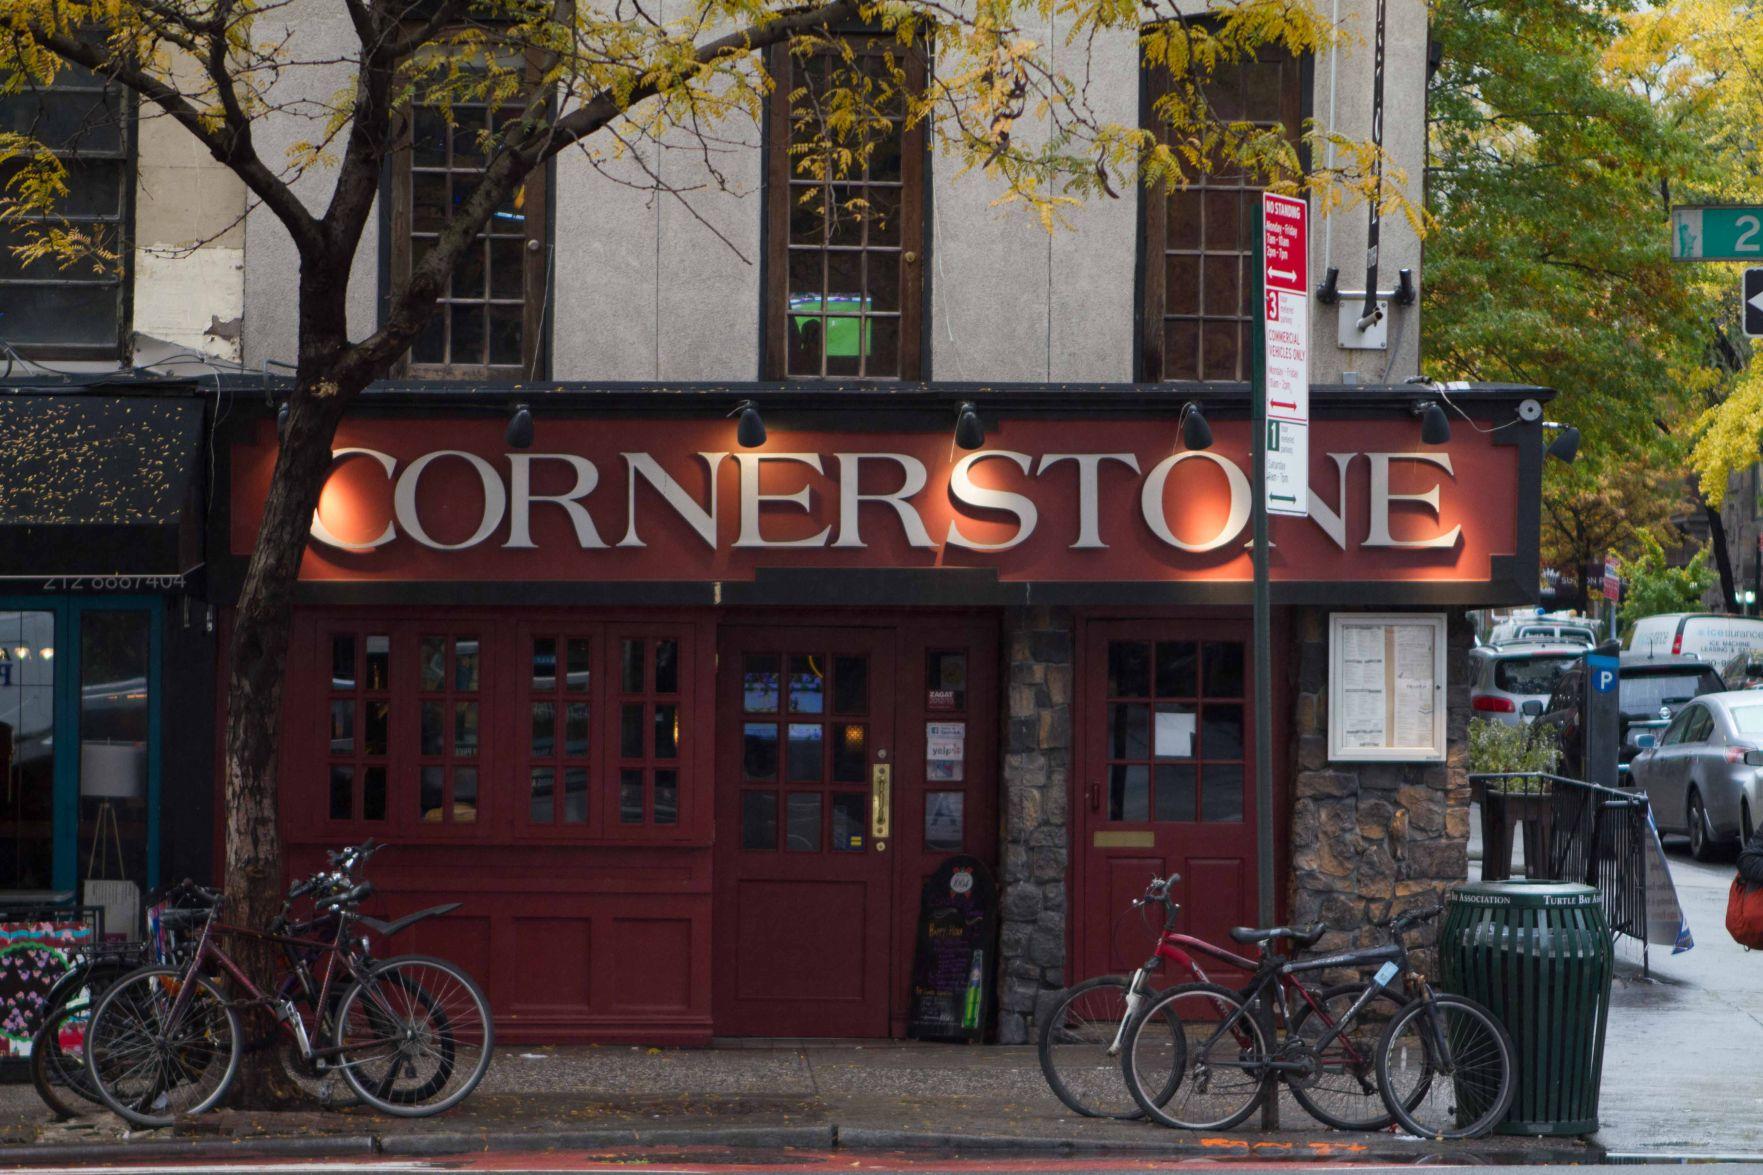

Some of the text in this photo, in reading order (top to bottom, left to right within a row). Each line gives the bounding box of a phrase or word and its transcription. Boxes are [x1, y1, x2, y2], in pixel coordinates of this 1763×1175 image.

[1266, 200, 1301, 220] NO STANDING
[1266, 220, 1282, 235] Monday
[1284, 223, 1298, 239] Friday
[1735, 215, 1761, 252] 2
[1269, 291, 1277, 319] 3
[1269, 329, 1300, 346] COMMERCIAL
[1269, 344, 1305, 361] VEHICLES ONLY
[310, 447, 1462, 551] CORNERSTONE
[1600, 672, 1613, 689] P
[929, 690, 955, 698] ZAGAT
[1460, 892, 1511, 904] ASSOCIATION
[1543, 895, 1577, 905] TURTLE
[1578, 894, 1592, 904] BAY
